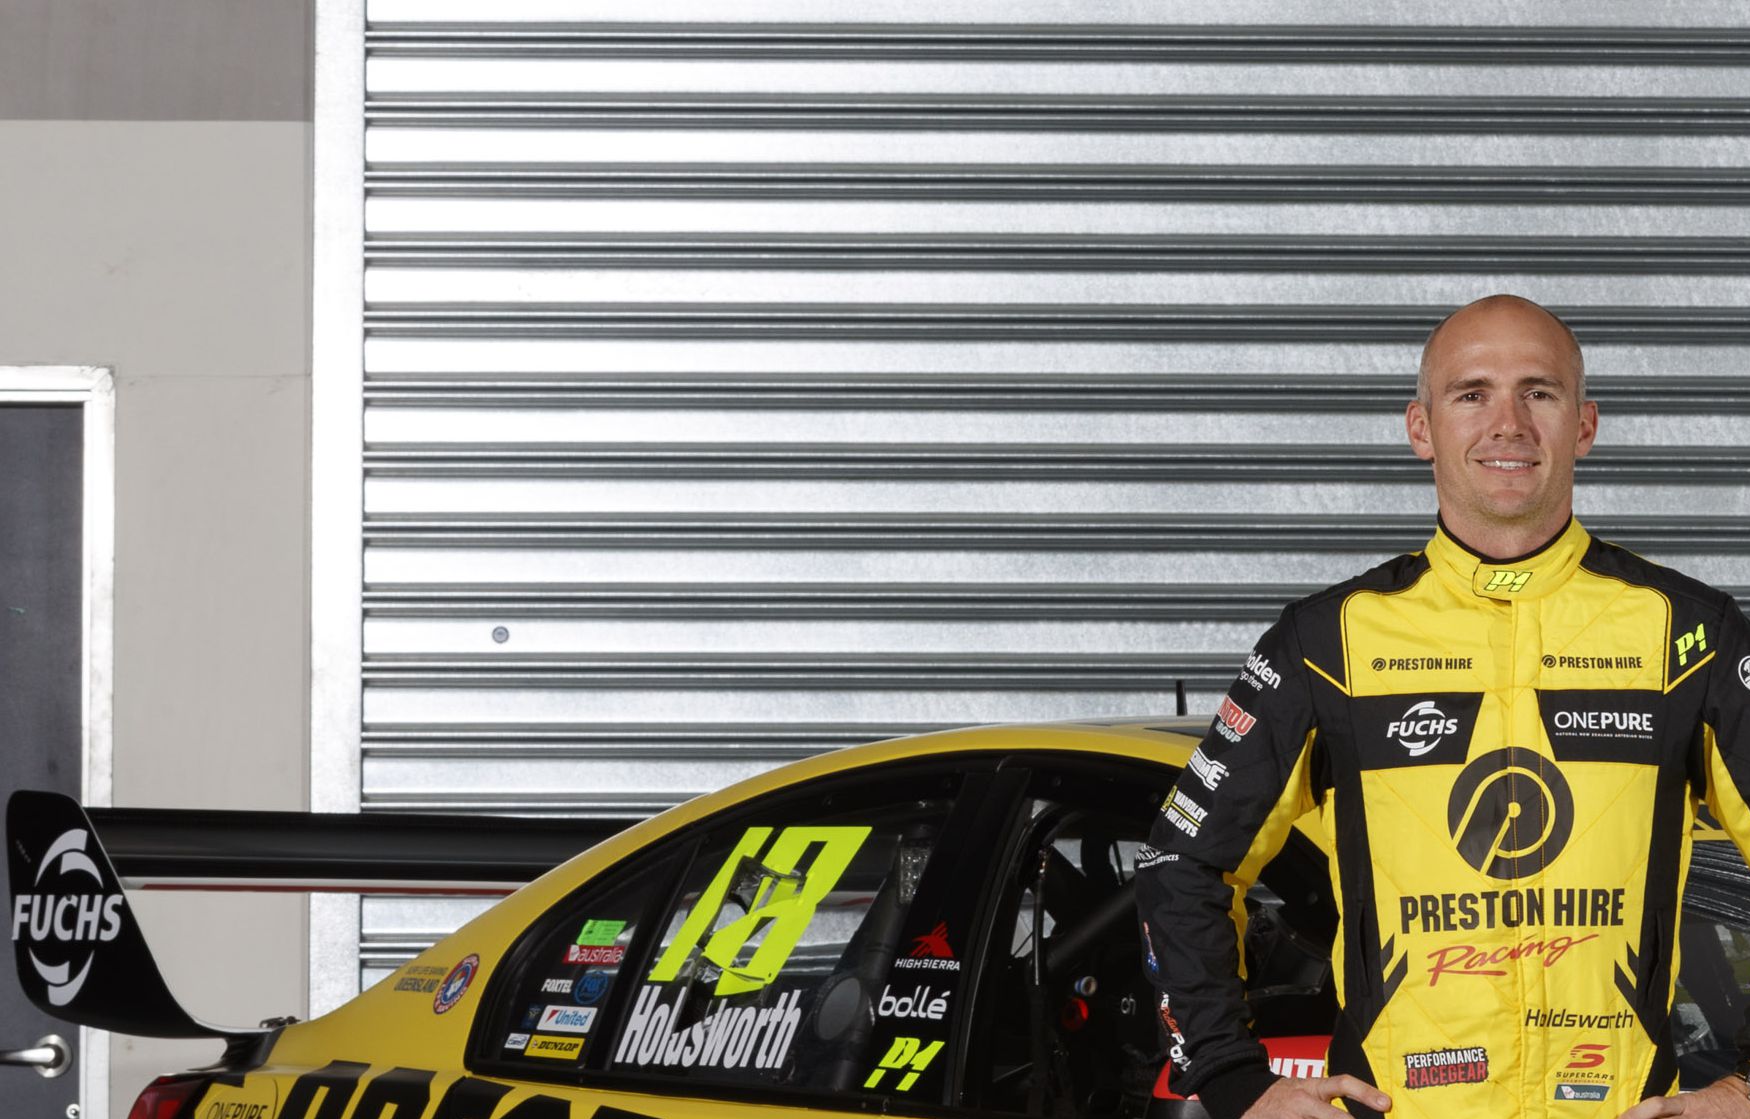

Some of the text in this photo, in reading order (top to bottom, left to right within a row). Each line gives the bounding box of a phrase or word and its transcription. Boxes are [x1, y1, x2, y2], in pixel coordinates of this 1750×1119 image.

[1674, 623, 1708, 667] P1
[1389, 657, 1473, 671] PRESTON HIRE
[1559, 656, 1643, 669] PRESTON HIRE
[1386, 718, 1459, 738] FUCHS
[1554, 711, 1654, 732] ONEPURE
[11, 893, 124, 942] FUCHS
[648, 826, 873, 996] 18
[1401, 887, 1625, 935] PRESTON HIRE
[1426, 934, 1600, 987] Racing
[541, 978, 574, 994] FOXTEL
[555, 1009, 590, 1027] United
[614, 985, 802, 1069] Holdsworth
[1525, 1008, 1634, 1030] Holdsworth
[537, 1040, 580, 1052] DUNLOP
[863, 1036, 945, 1092] P1
[1406, 1048, 1486, 1069] PERFORMANCE
[1408, 1063, 1488, 1088] RACEGEAR
[1556, 1071, 1615, 1081] SUPERCARS
